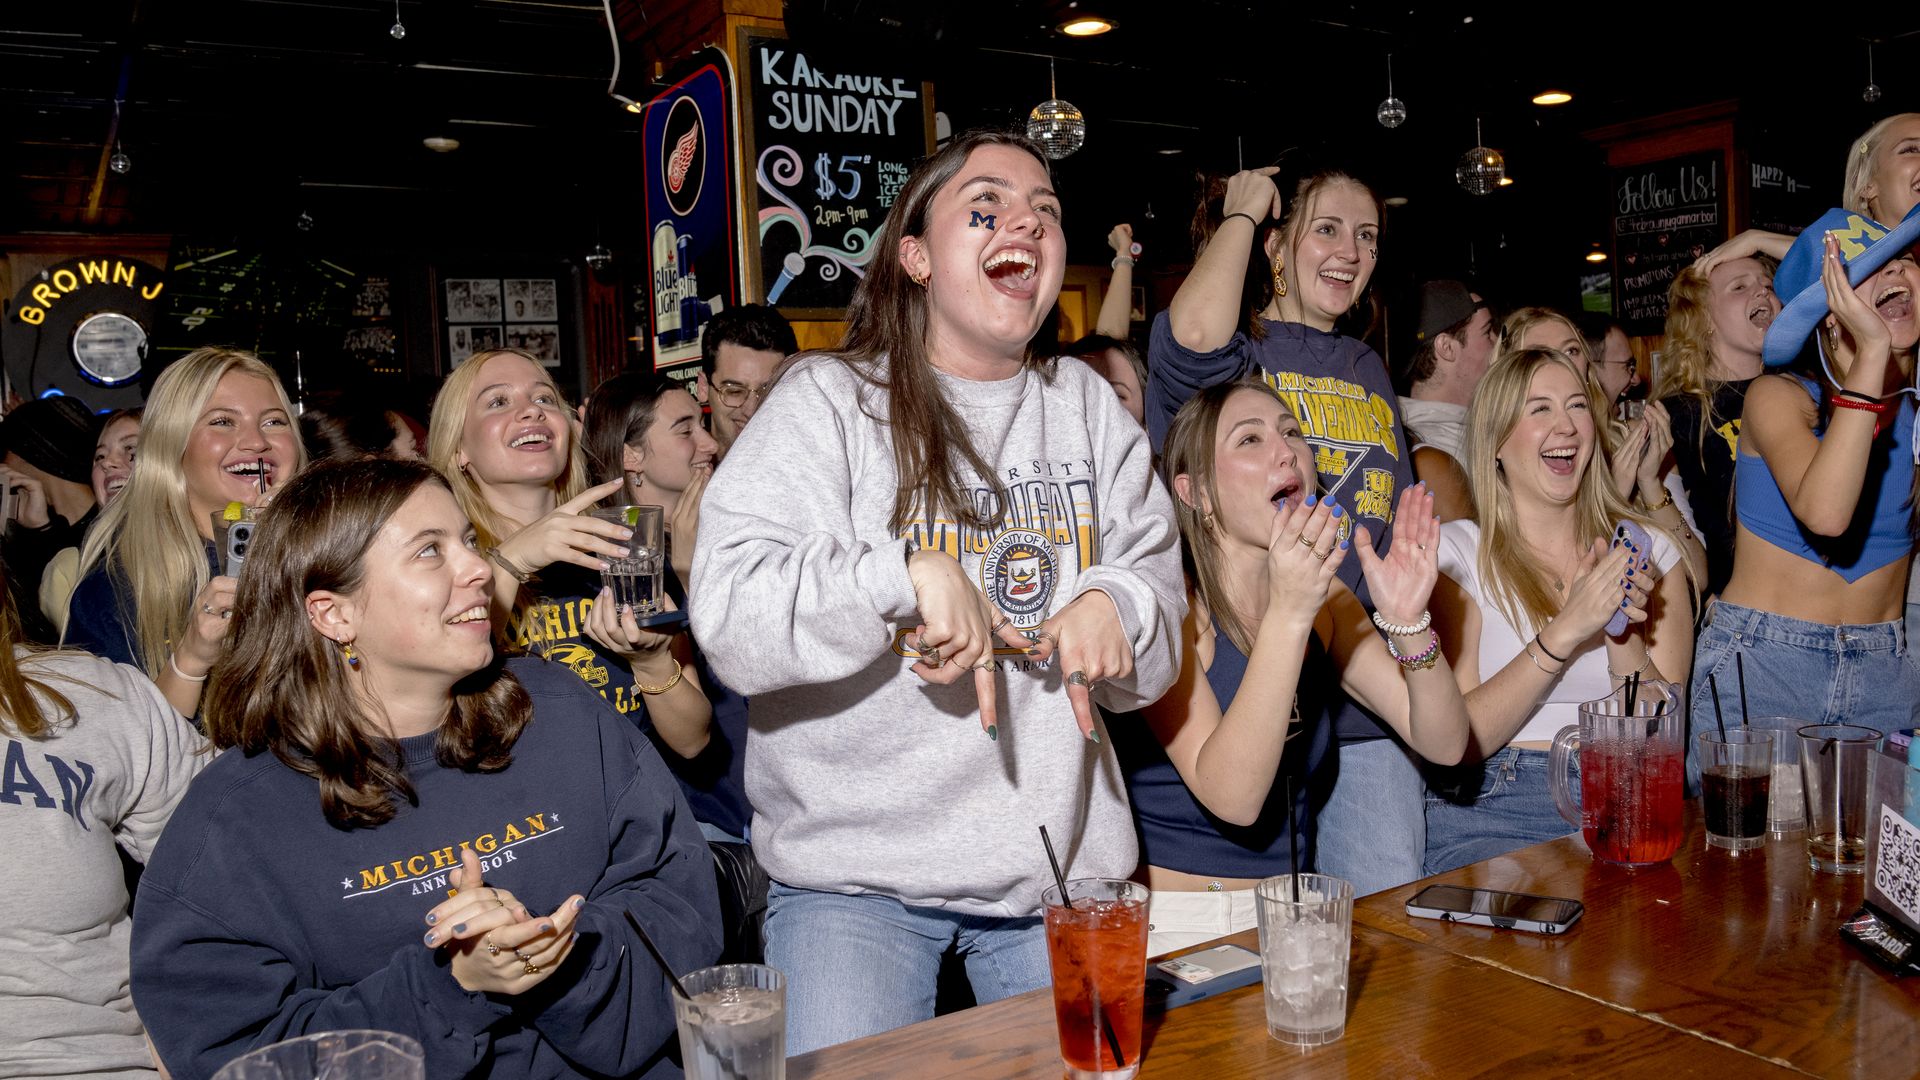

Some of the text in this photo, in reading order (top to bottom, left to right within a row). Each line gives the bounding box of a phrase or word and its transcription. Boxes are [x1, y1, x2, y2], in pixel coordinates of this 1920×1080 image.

[768, 90, 903, 136] SUNDAY
[877, 160, 908, 175] LONG
[878, 173, 912, 186] ISLAN
[1751, 162, 1784, 188] HAPPY
[1680, 160, 1717, 204] Us!
[875, 195, 898, 208] TE
[969, 210, 997, 231] M
[655, 267, 678, 294] Blue
[1623, 265, 1675, 292] PROMOTIONS
[19, 260, 136, 325] BROWN
[657, 290, 680, 317] LIGHT
[1277, 371, 1368, 401] MICHIGAN
[985, 533, 1023, 580] UNIVERSITY
[1024, 533, 1042, 545] OF
[1012, 613, 1037, 625] 1817
[411, 874, 447, 896] ANN
[481, 849, 517, 874] BOR
